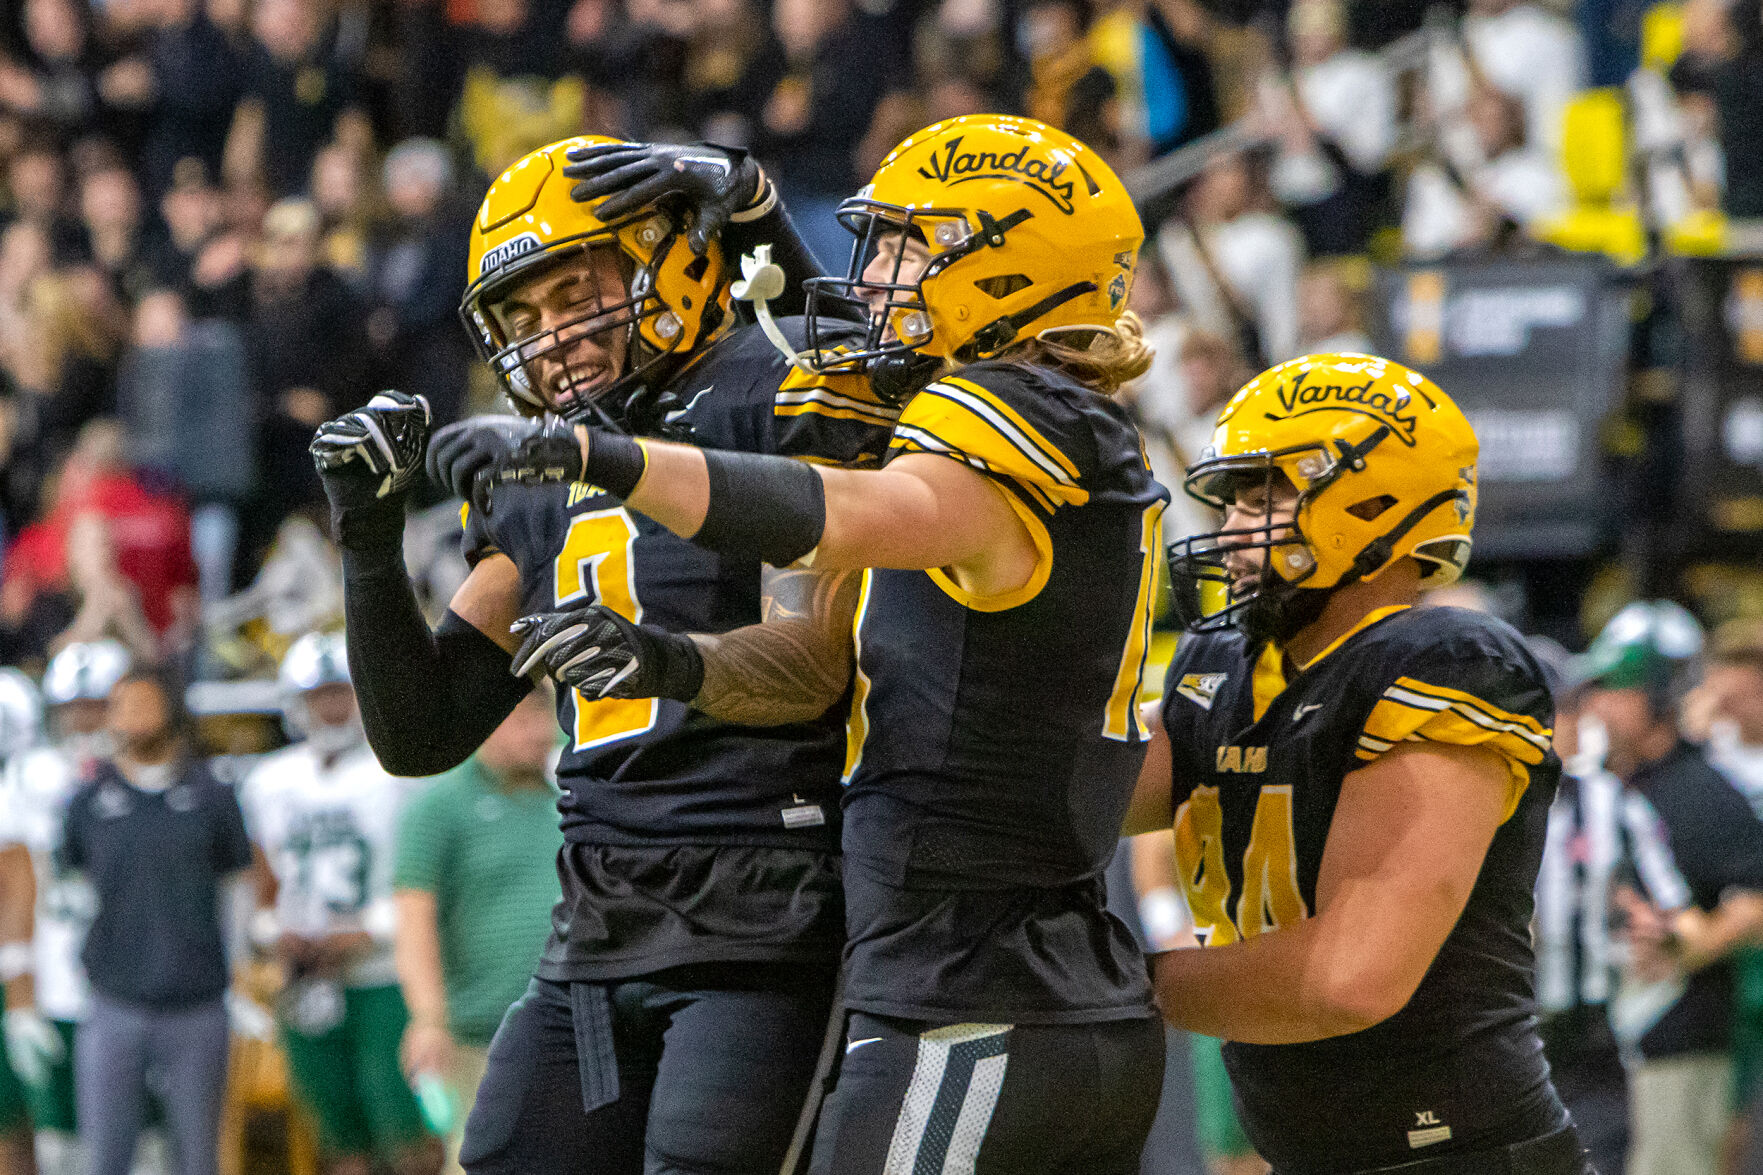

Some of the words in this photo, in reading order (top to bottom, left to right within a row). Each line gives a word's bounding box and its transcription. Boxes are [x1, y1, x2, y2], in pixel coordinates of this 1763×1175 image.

[917, 135, 1075, 216] Vandals
[483, 238, 533, 272] IDAHO
[1264, 371, 1417, 448] Vandals
[554, 505, 659, 753] 2
[792, 792, 806, 804] L
[1173, 783, 1309, 947] 94
[1415, 1110, 1441, 1126] XL
